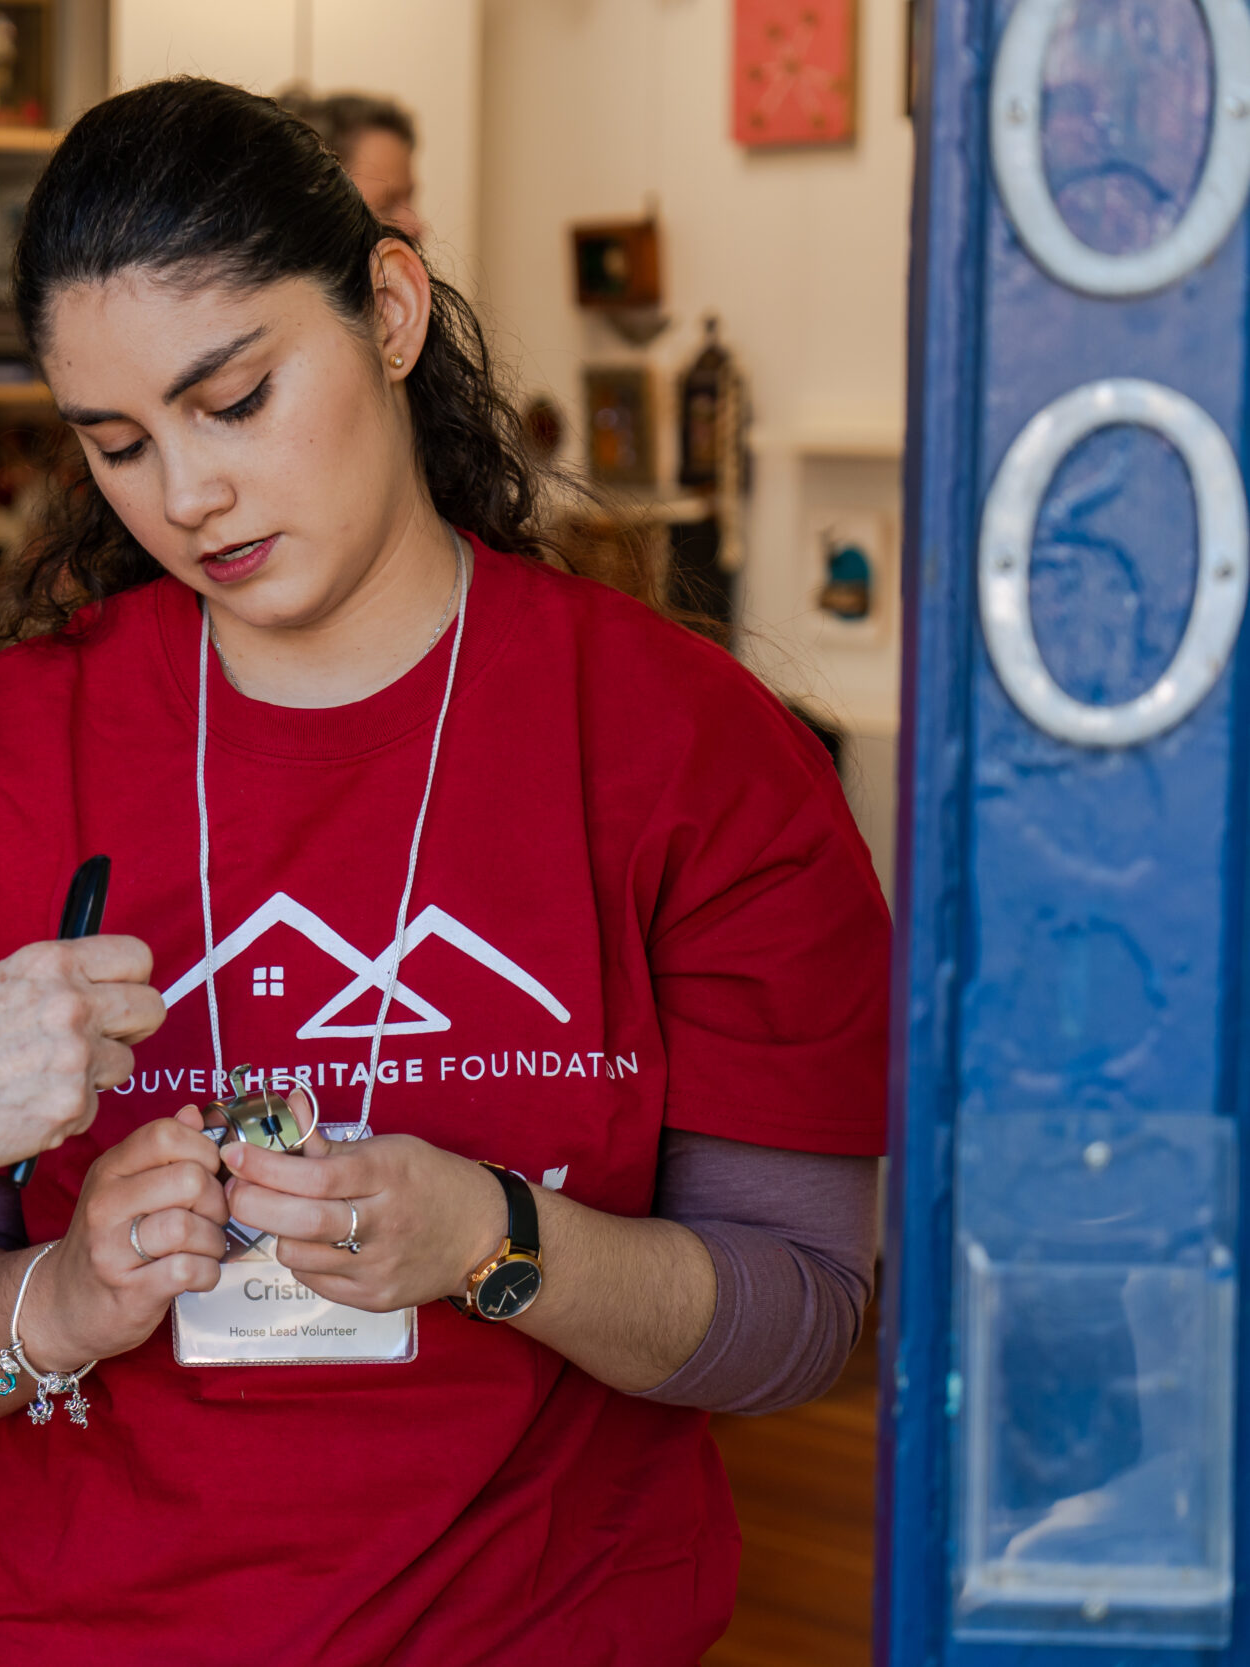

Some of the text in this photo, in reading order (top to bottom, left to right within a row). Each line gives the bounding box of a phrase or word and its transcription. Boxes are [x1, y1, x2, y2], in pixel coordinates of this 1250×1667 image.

[244, 1056, 423, 1092] HERITAGE
[243, 1277, 316, 1301] Cristi
[229, 1325, 357, 1338] House Lead Volunteer
